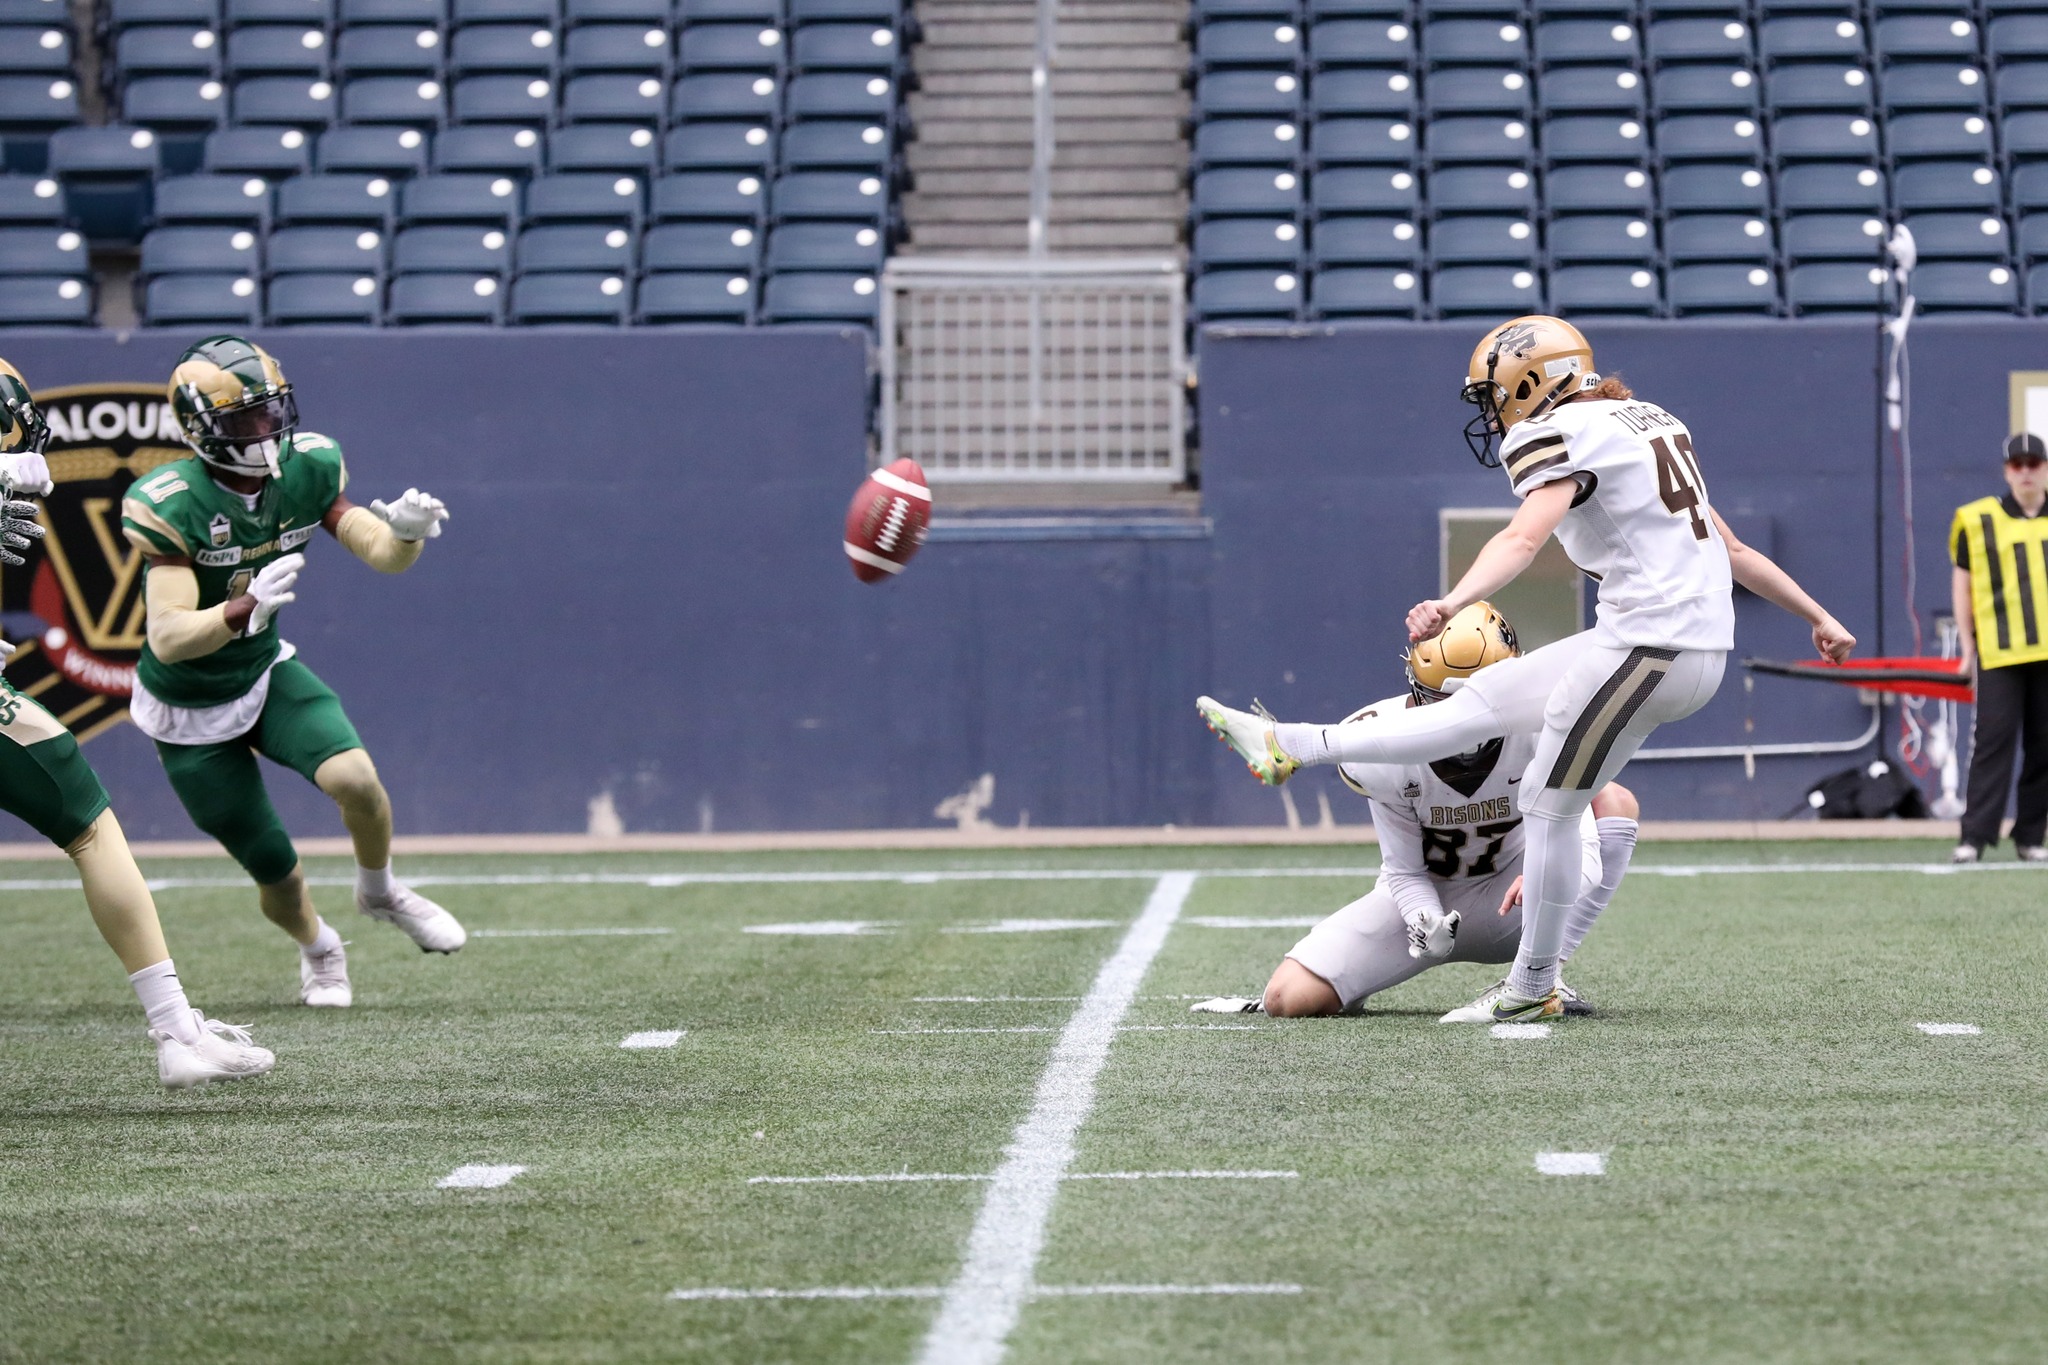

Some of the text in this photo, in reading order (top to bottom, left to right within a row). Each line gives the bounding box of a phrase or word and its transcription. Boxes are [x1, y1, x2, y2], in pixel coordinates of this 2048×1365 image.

[40, 400, 183, 443] ALOUR
[139, 470, 190, 504] 11
[1430, 796, 1511, 825] BISONS
[1422, 817, 1523, 878] 87
